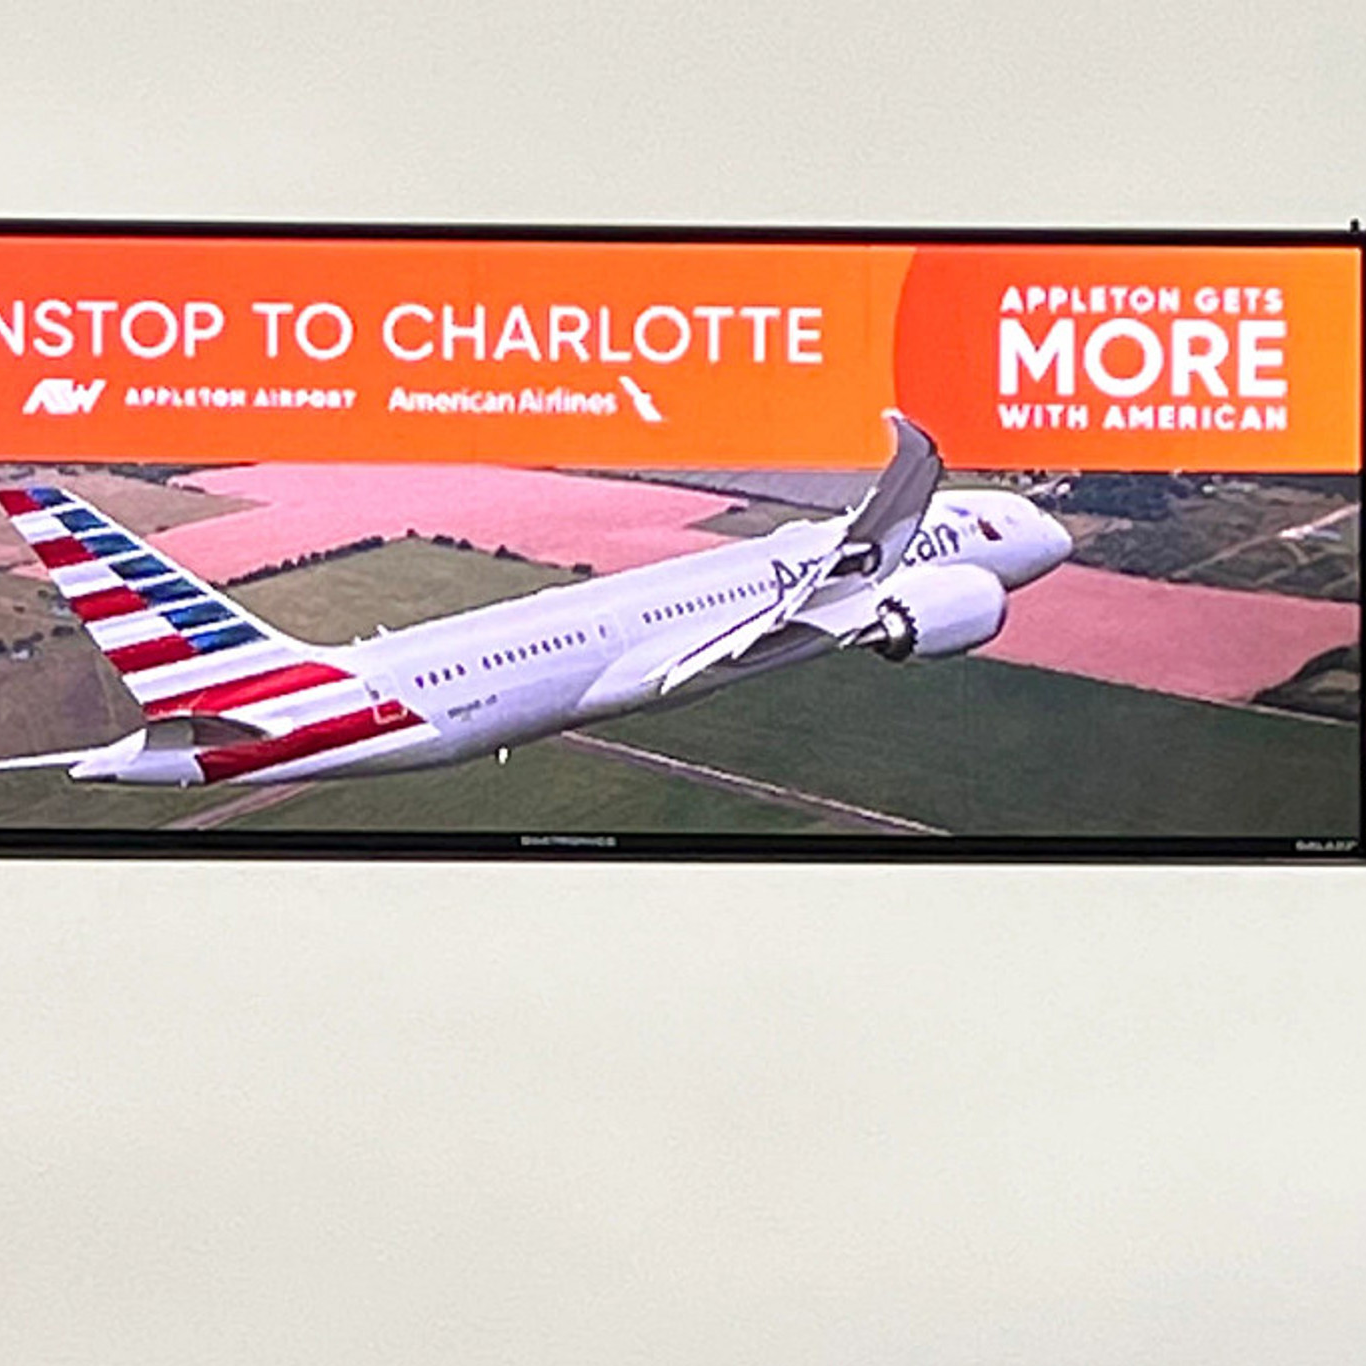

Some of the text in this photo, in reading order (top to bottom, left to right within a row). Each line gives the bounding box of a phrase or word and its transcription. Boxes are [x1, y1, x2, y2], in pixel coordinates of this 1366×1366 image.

[1000, 286, 1284, 314] APPLETON GETS
[252, 303, 353, 361] TO
[382, 304, 823, 363] CHARLOTTE
[998, 317, 1288, 398] MORE
[124, 386, 357, 410] APPLETON AIRPORT
[388, 386, 618, 415] American Airlines
[998, 403, 1288, 431] WITH AMERICAN
